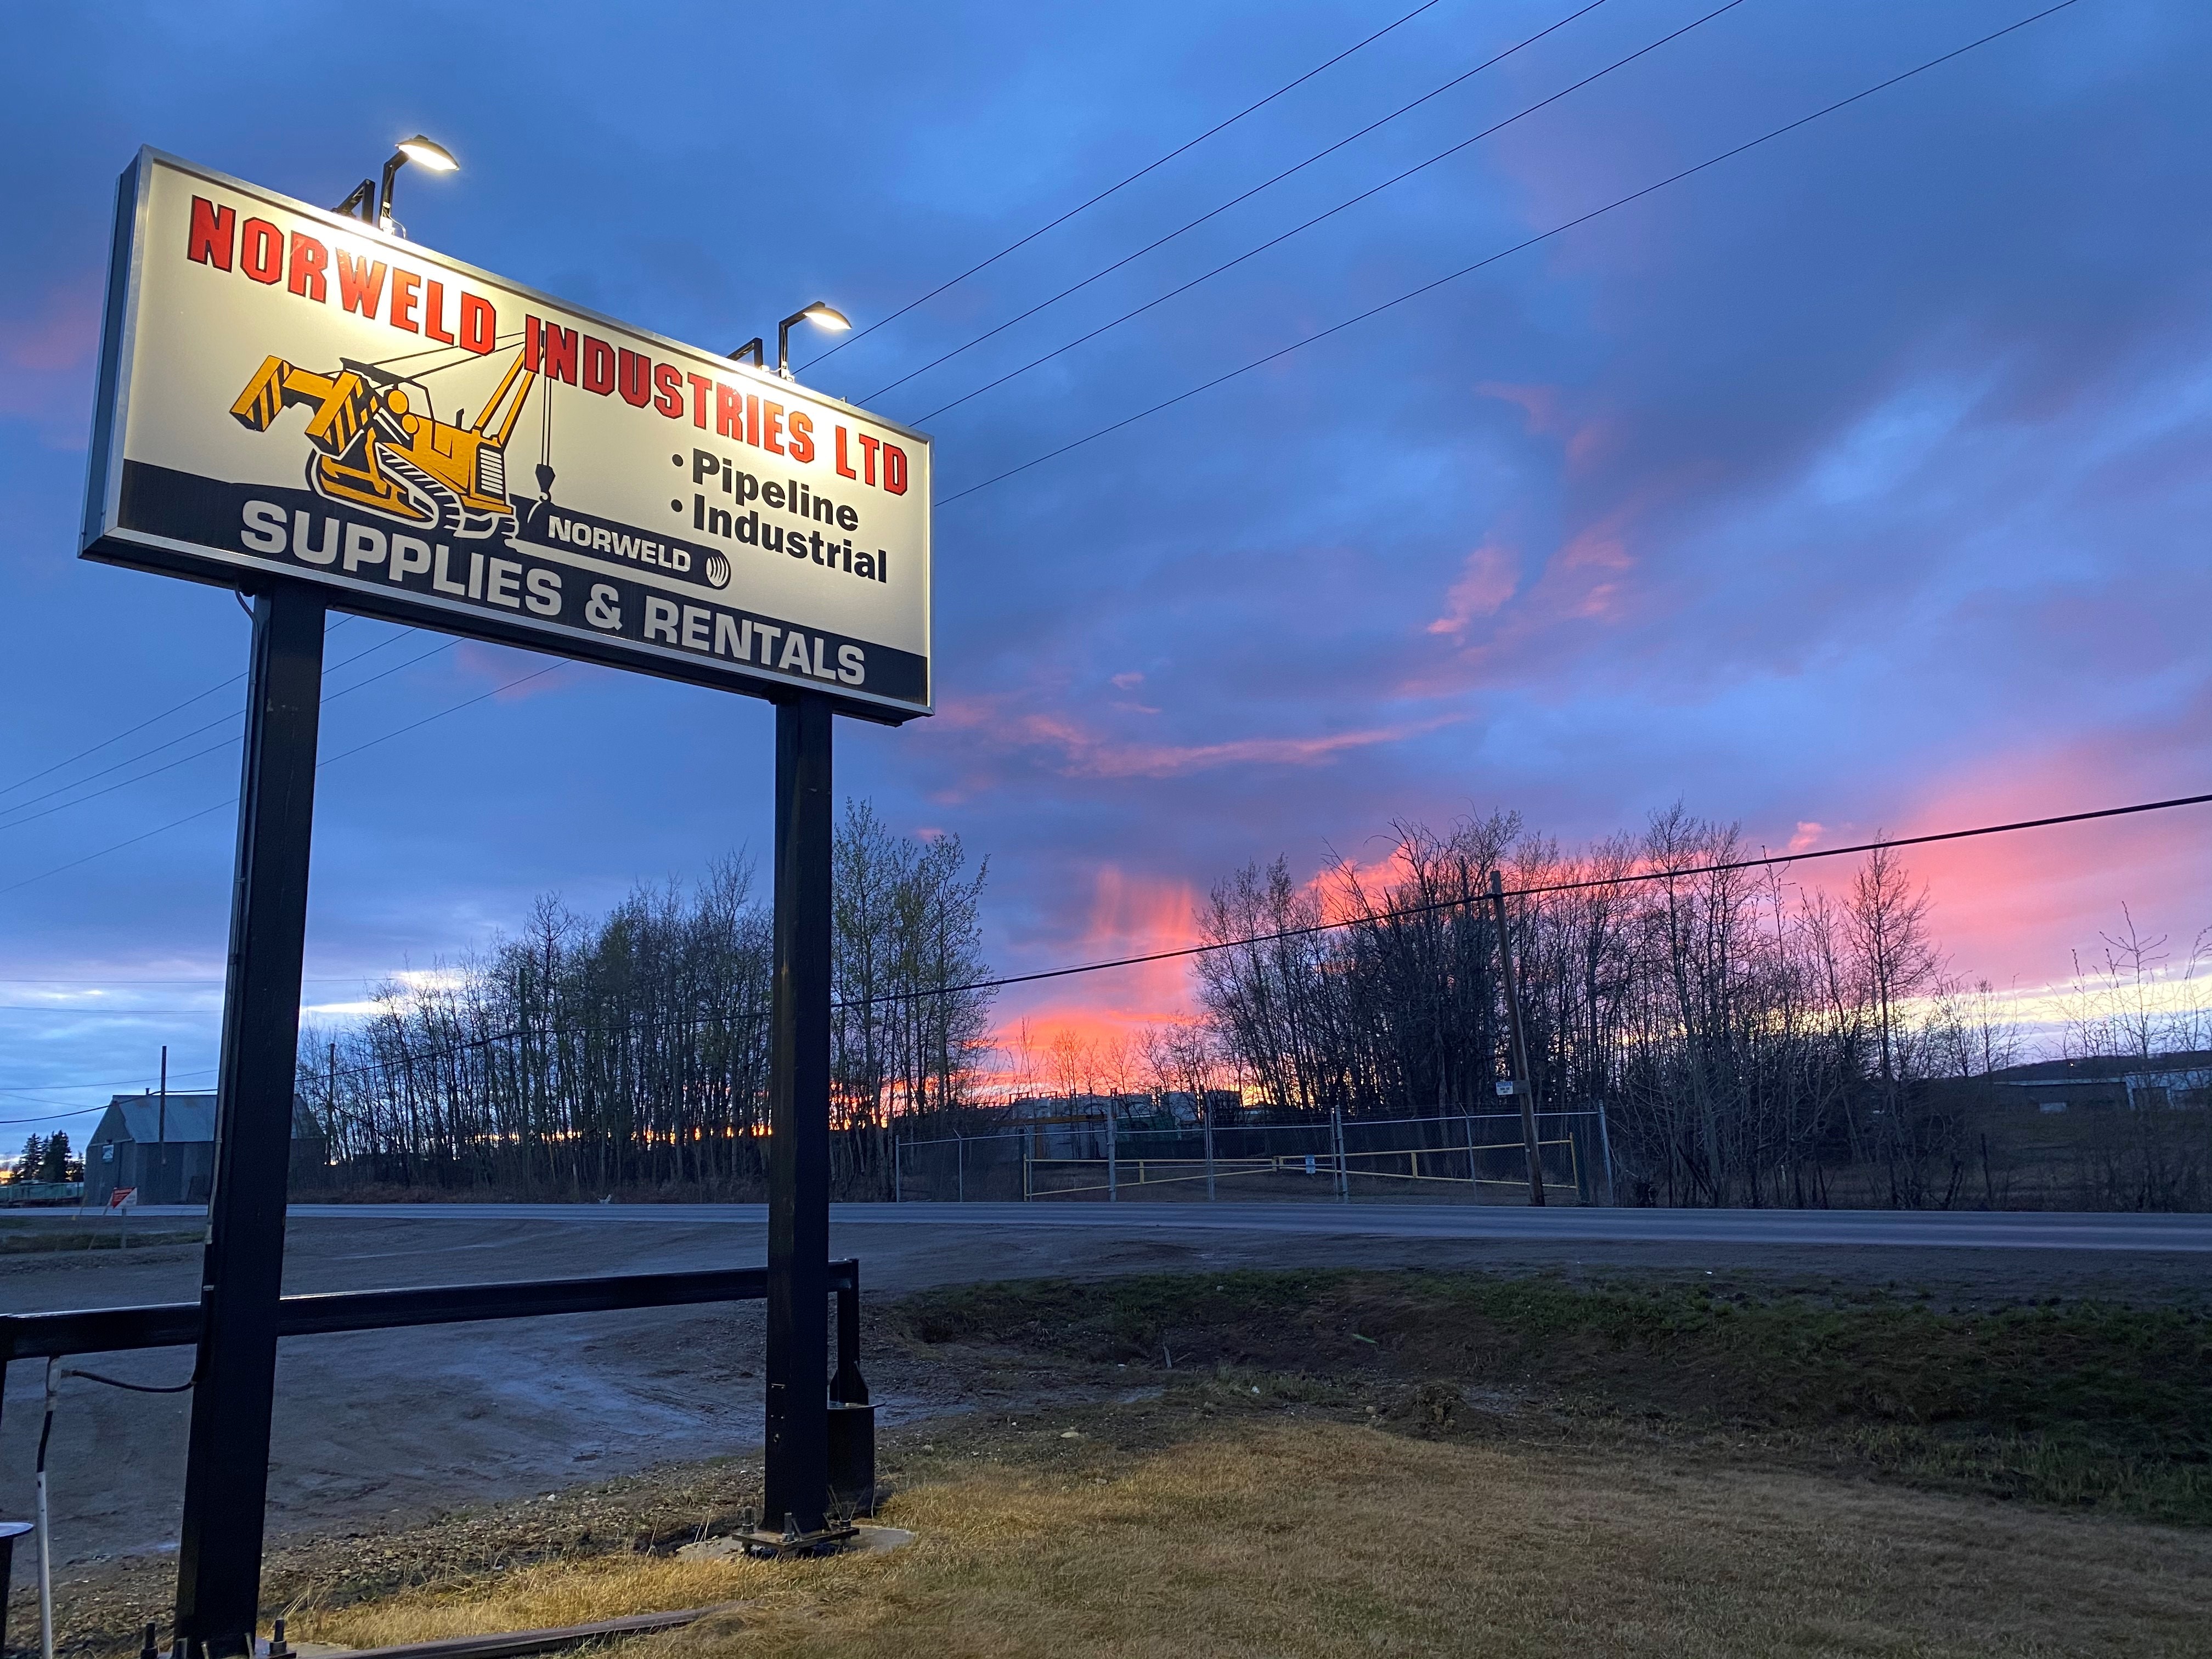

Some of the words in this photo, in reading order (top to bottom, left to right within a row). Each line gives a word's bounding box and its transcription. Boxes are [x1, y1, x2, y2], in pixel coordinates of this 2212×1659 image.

[187, 195, 496, 356] NORWELD
[523, 314, 815, 464] INDUSTRIES
[835, 425, 908, 496] LTD
[693, 448, 859, 532] Pipeline
[549, 515, 691, 573] NORWELD
[693, 495, 887, 583] Industrial
[240, 500, 562, 616] SUPPLIES
[585, 583, 622, 630] &
[644, 596, 866, 686] RENTALS
